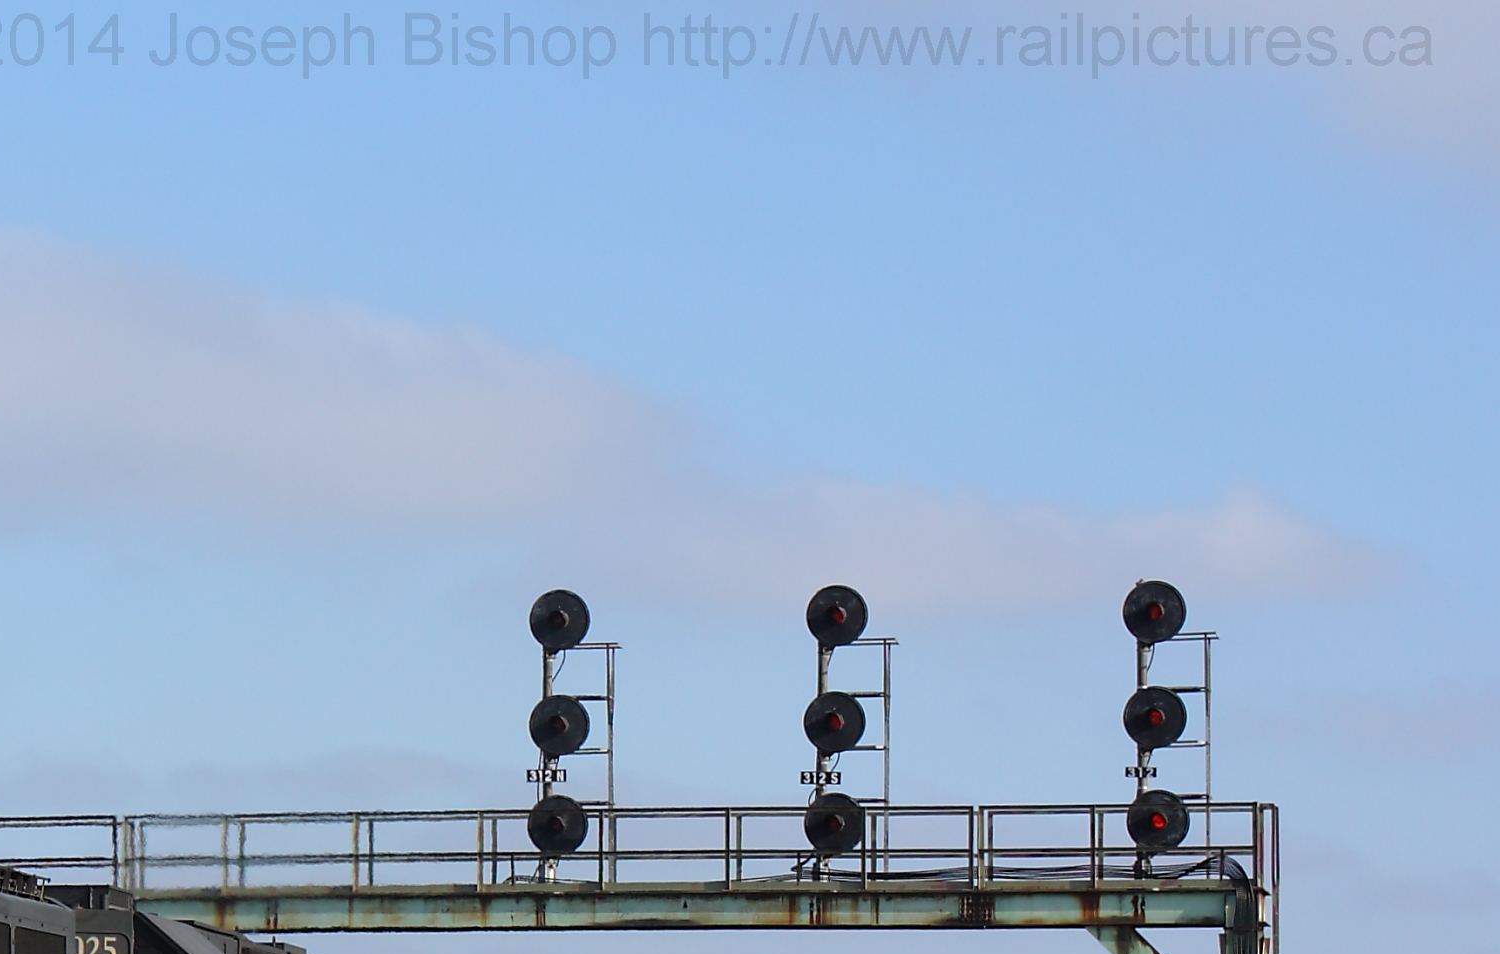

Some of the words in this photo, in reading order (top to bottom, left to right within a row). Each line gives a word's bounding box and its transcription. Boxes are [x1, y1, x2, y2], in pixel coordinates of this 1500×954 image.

[529, 770, 552, 782] 312
[556, 770, 565, 782] N
[803, 772, 827, 784] 312
[830, 772, 839, 784] S
